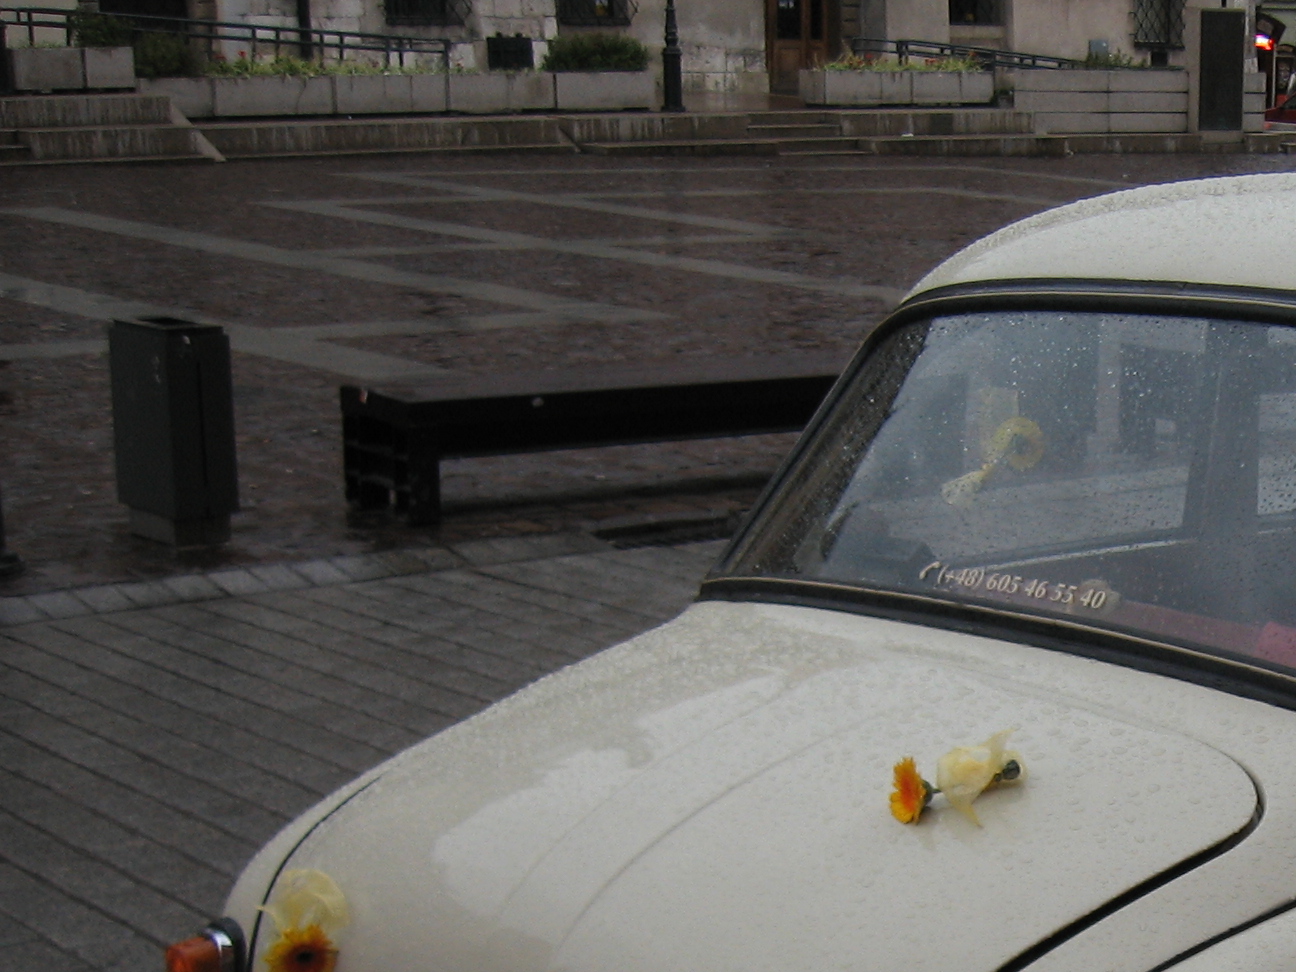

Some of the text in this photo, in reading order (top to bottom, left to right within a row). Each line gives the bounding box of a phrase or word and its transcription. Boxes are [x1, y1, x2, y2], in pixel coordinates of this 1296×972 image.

[937, 565, 1107, 610] (+48) 605 46 55 40
